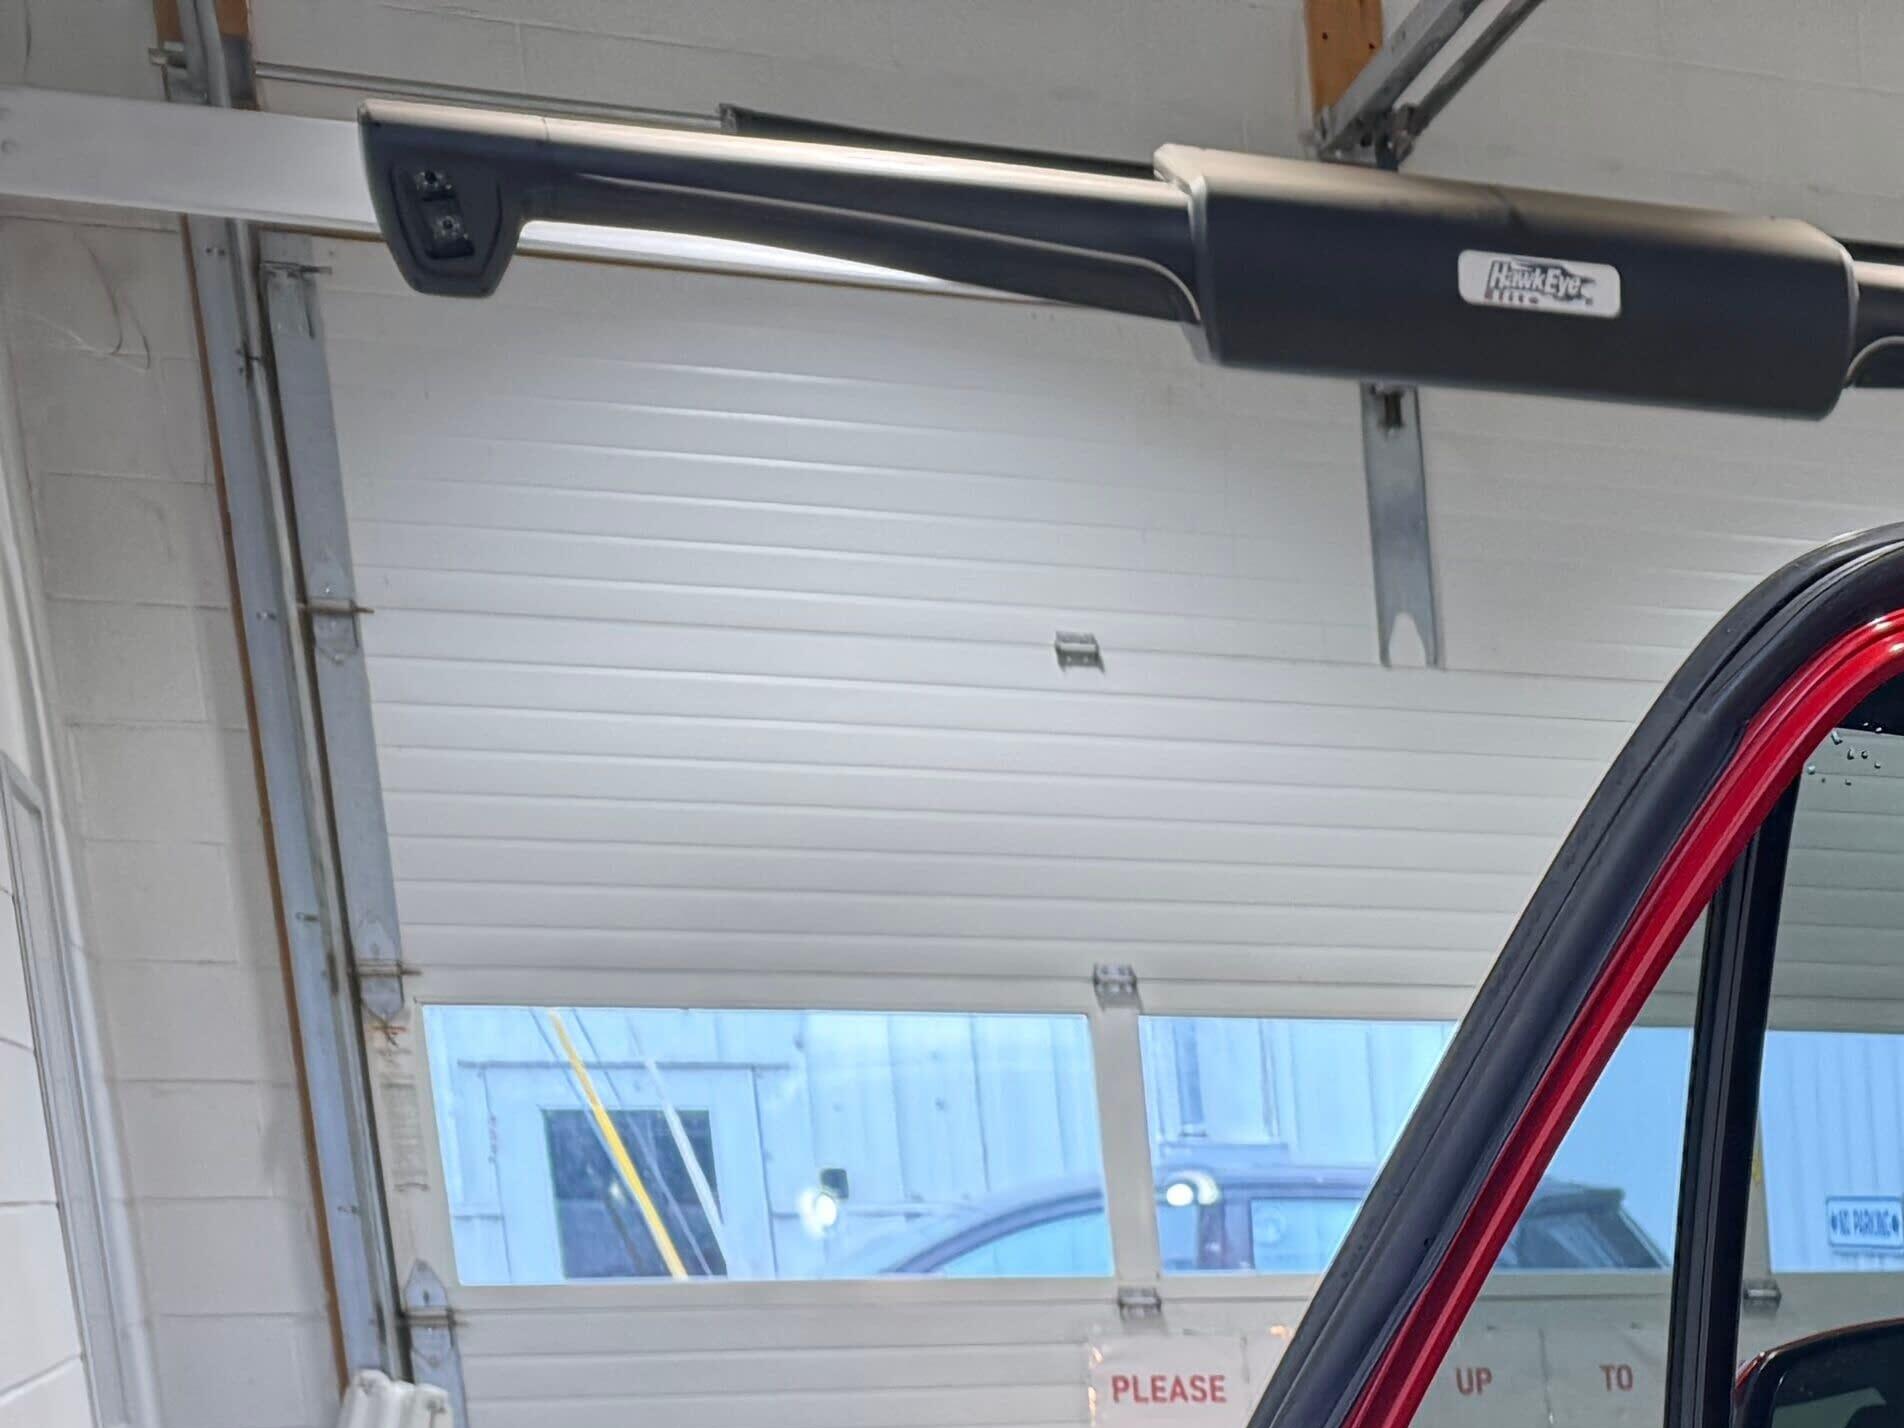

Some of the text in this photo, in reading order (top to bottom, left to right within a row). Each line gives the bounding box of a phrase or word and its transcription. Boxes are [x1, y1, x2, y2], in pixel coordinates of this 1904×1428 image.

[1111, 1363, 1634, 1404] PLEASE UP TO
